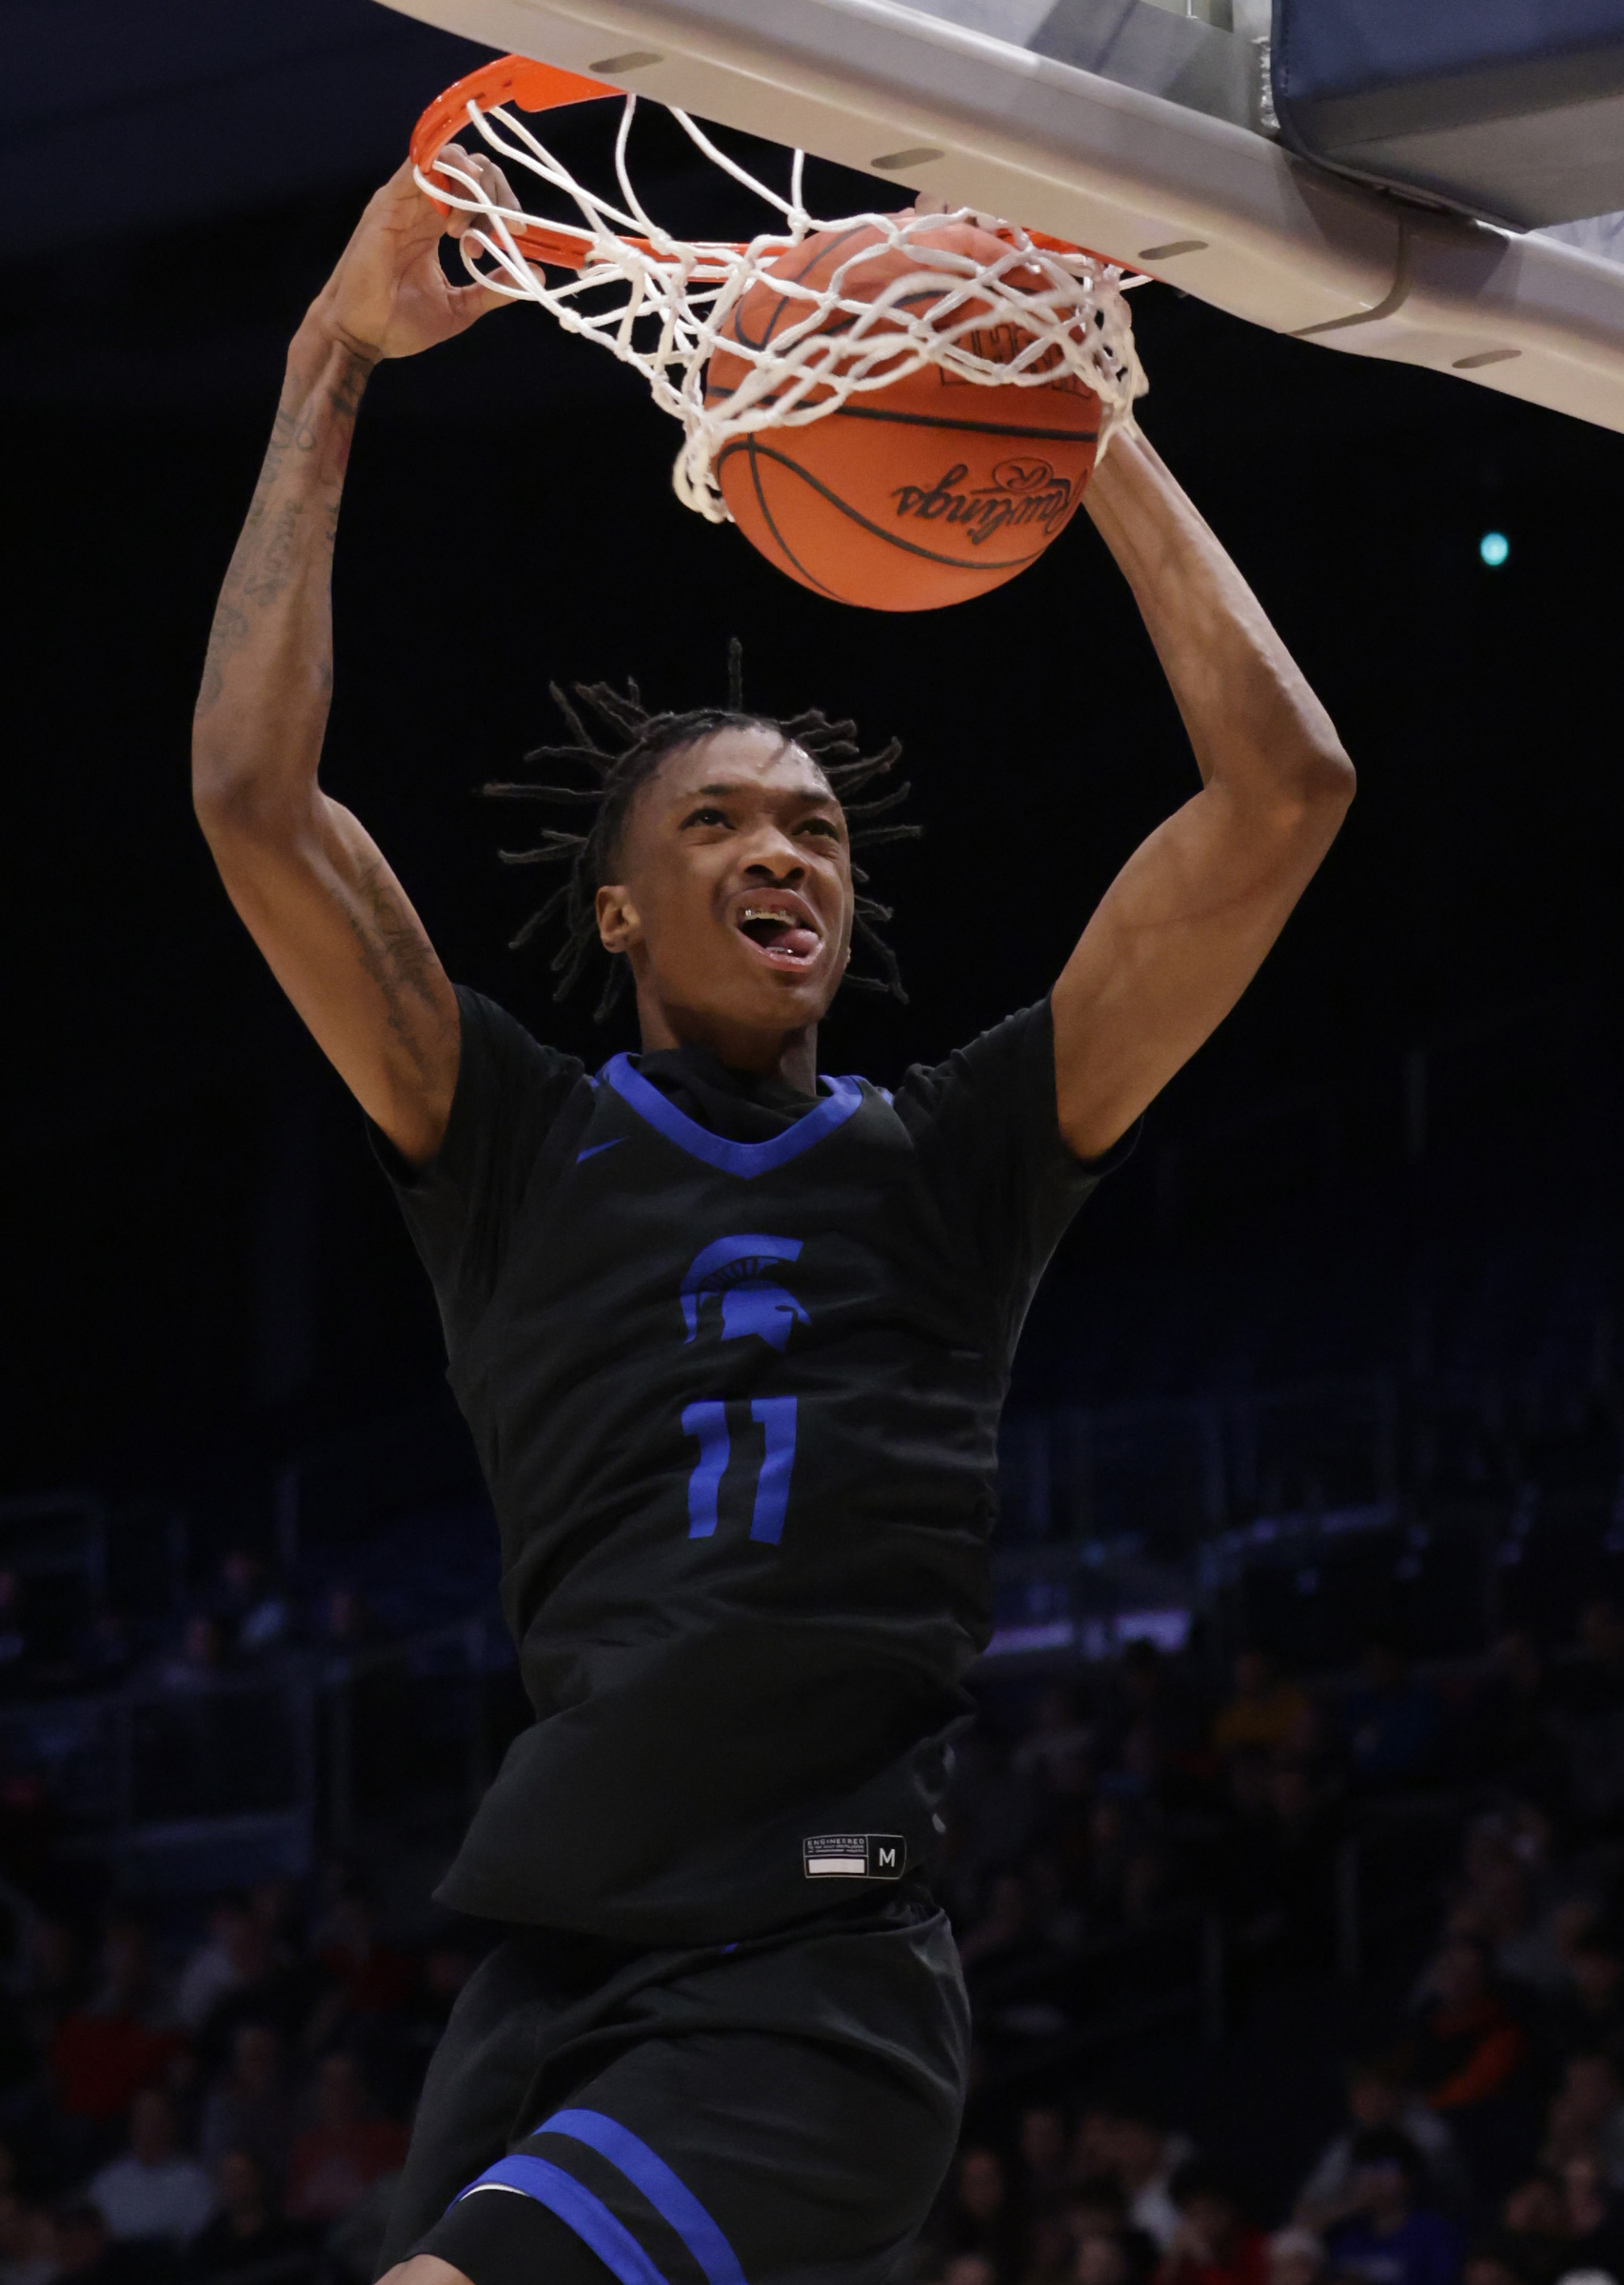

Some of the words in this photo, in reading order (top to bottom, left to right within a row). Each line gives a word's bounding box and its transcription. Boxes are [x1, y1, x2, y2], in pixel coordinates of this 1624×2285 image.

[890, 464, 1088, 546] Rawlings
[681, 1395, 798, 1545] 11
[806, 1838, 865, 1846] ENGINEERED
[879, 1847, 896, 1868] M
